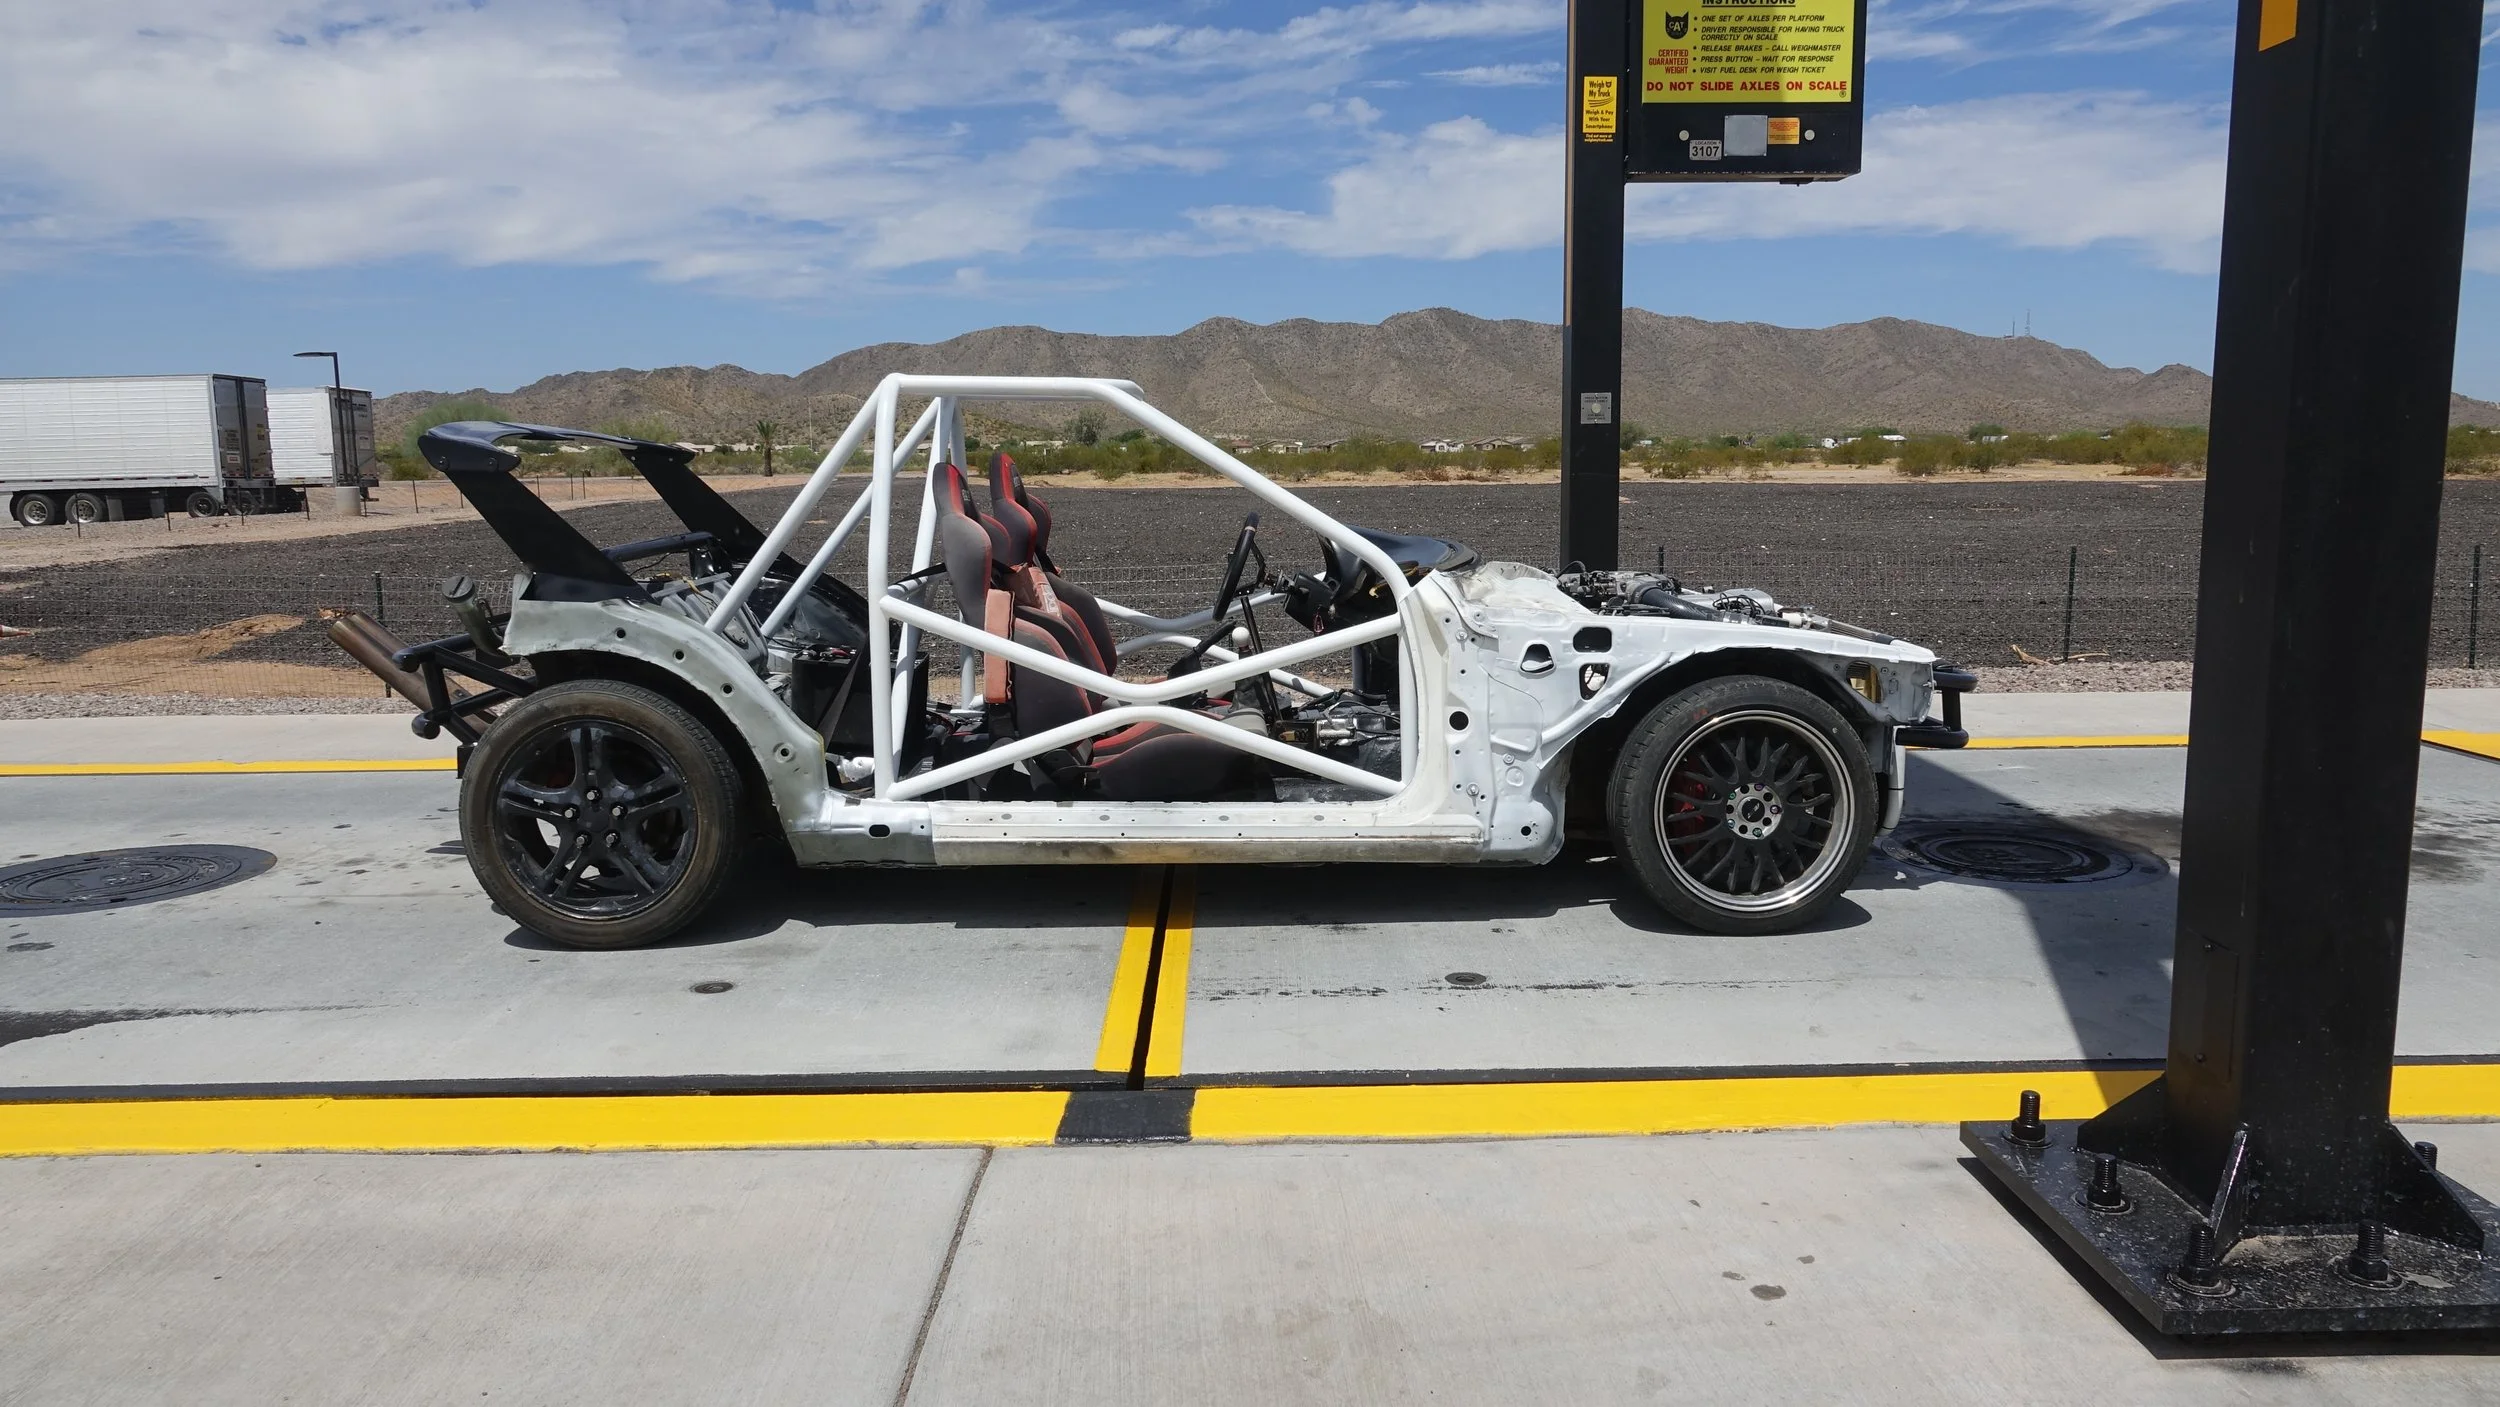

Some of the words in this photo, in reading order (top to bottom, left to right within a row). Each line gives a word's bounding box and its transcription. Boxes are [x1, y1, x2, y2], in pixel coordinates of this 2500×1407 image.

[1668, 22, 1685, 31] CAT
[1589, 80, 1604, 90] Weigh
[1646, 81, 1663, 91] DO
[1669, 81, 1694, 91] NOT
[1700, 81, 1733, 91] SLIDE
[1740, 81, 1780, 91] AXLES
[1786, 81, 1802, 91] ON
[1809, 81, 1847, 91] SCALE
[1692, 146, 1719, 157] 3107
